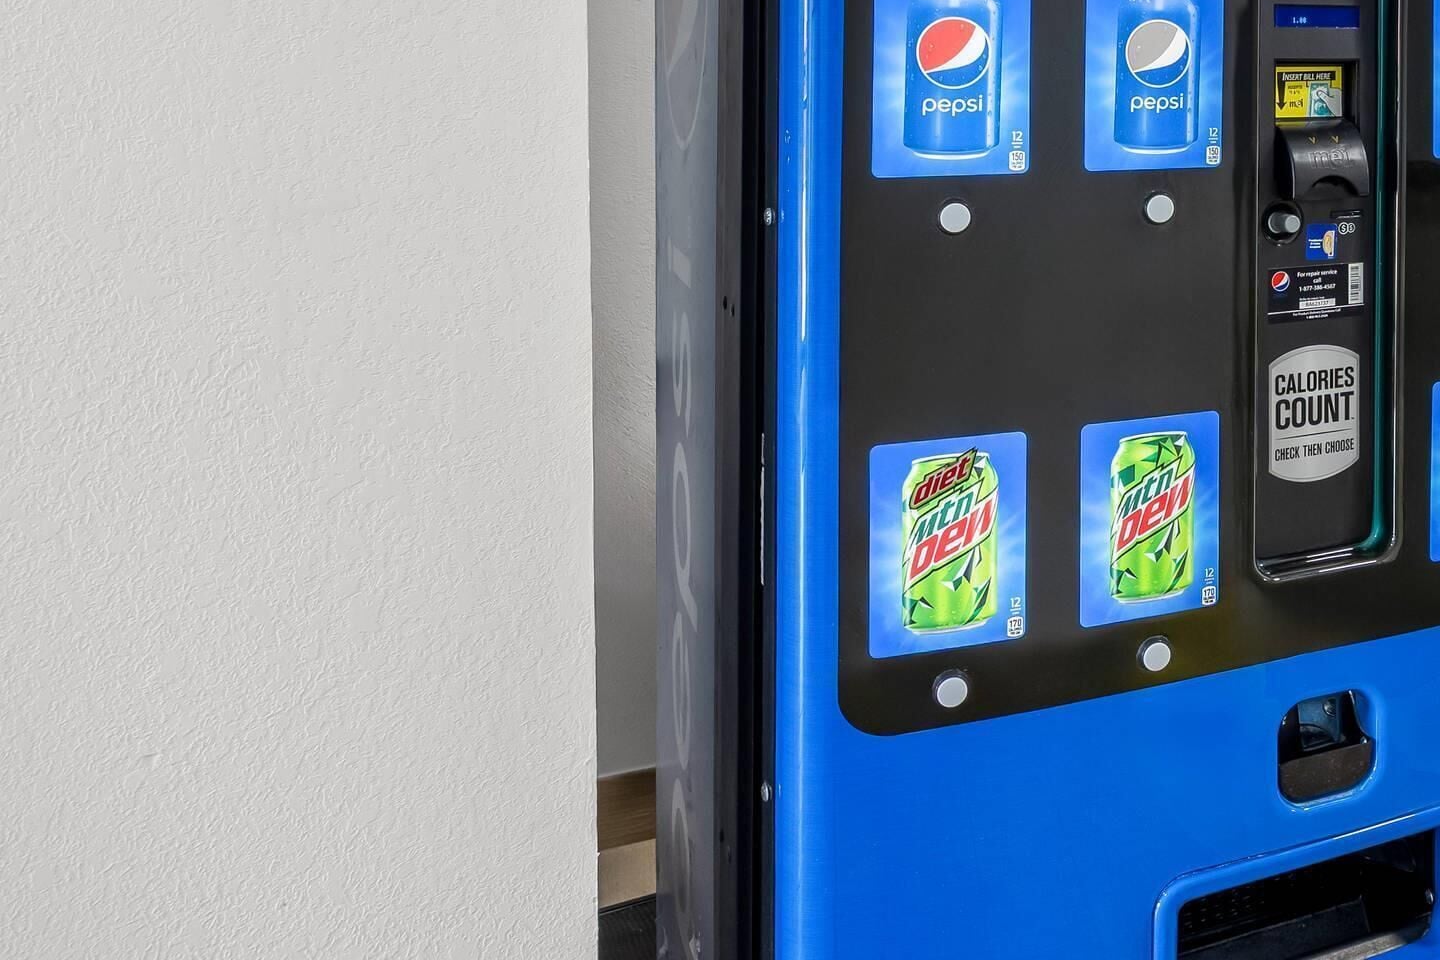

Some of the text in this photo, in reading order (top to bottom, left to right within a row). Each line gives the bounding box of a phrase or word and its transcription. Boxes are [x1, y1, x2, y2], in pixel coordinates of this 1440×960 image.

[1282, 72, 1331, 81] INSERT BILL HERE
[922, 94, 983, 117] pepsi
[1130, 93, 1184, 114] pepsi
[1011, 130, 1023, 142] 12
[1208, 127, 1219, 137] 12
[1011, 152, 1024, 161] 150
[1306, 270, 1320, 278] repair
[1275, 366, 1355, 396] CALORIES
[1275, 391, 1355, 430] COUNT
[1274, 438, 1355, 461] CHECK THEN CHOOSE
[913, 456, 972, 506] diet
[1205, 567, 1214, 578] 12
[1204, 588, 1215, 597] 170
[1010, 596, 1021, 608] 12
[1009, 619, 1022, 628] 170
